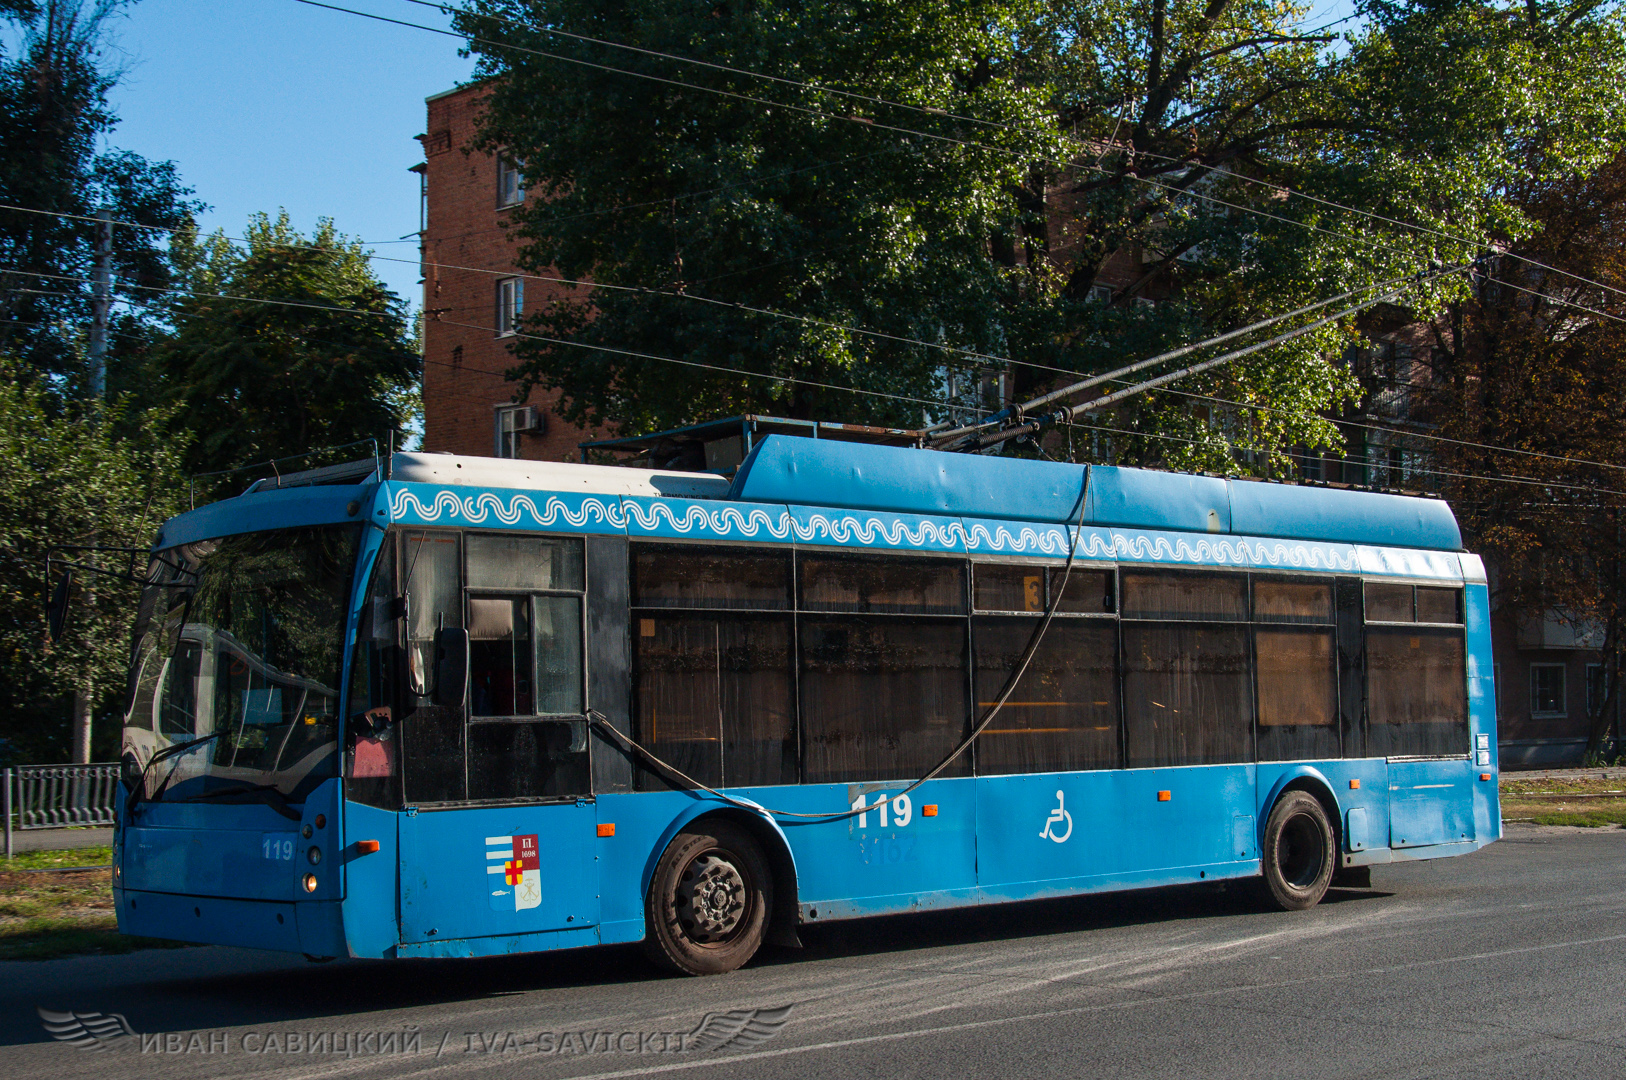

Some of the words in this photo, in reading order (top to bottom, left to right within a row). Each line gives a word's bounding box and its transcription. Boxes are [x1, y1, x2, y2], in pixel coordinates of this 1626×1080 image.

[1029, 581, 1042, 610] 3
[851, 793, 912, 828] 119
[263, 839, 293, 860] 119
[521, 850, 536, 858] 1698
